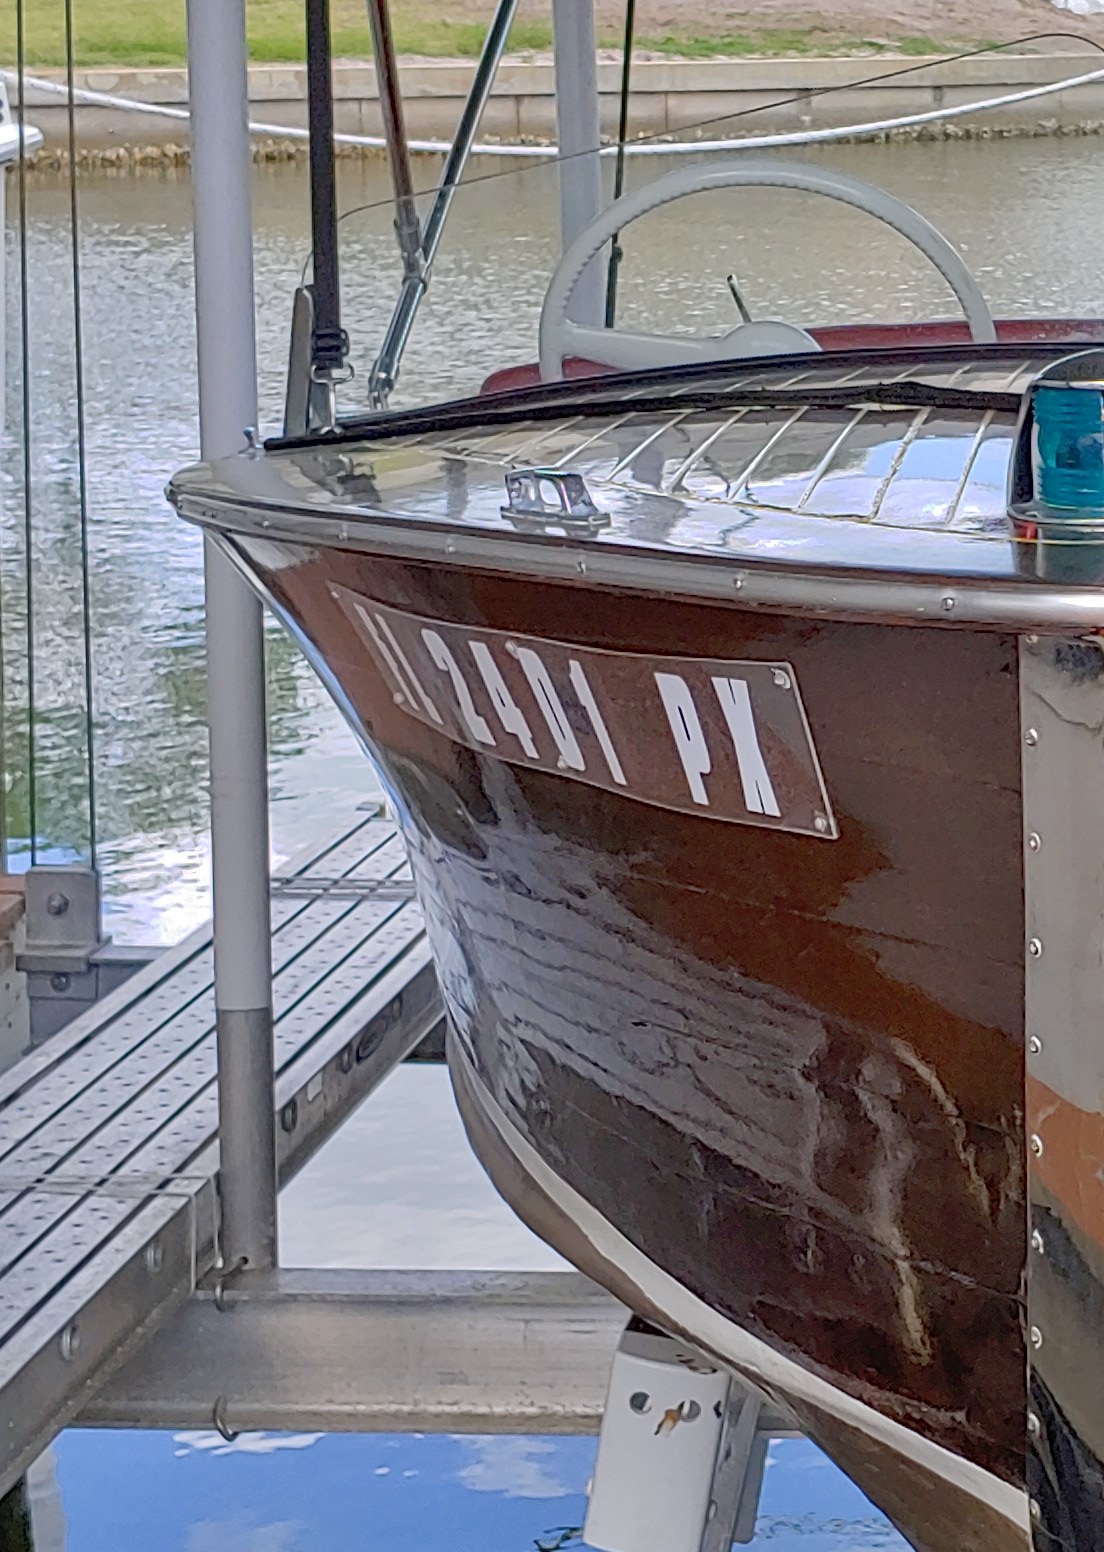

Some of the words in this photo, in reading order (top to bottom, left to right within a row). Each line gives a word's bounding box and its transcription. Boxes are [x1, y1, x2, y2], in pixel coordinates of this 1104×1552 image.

[353, 602, 444, 726] FL
[420, 628, 628, 787] 2401
[653, 671, 782, 818] PX
